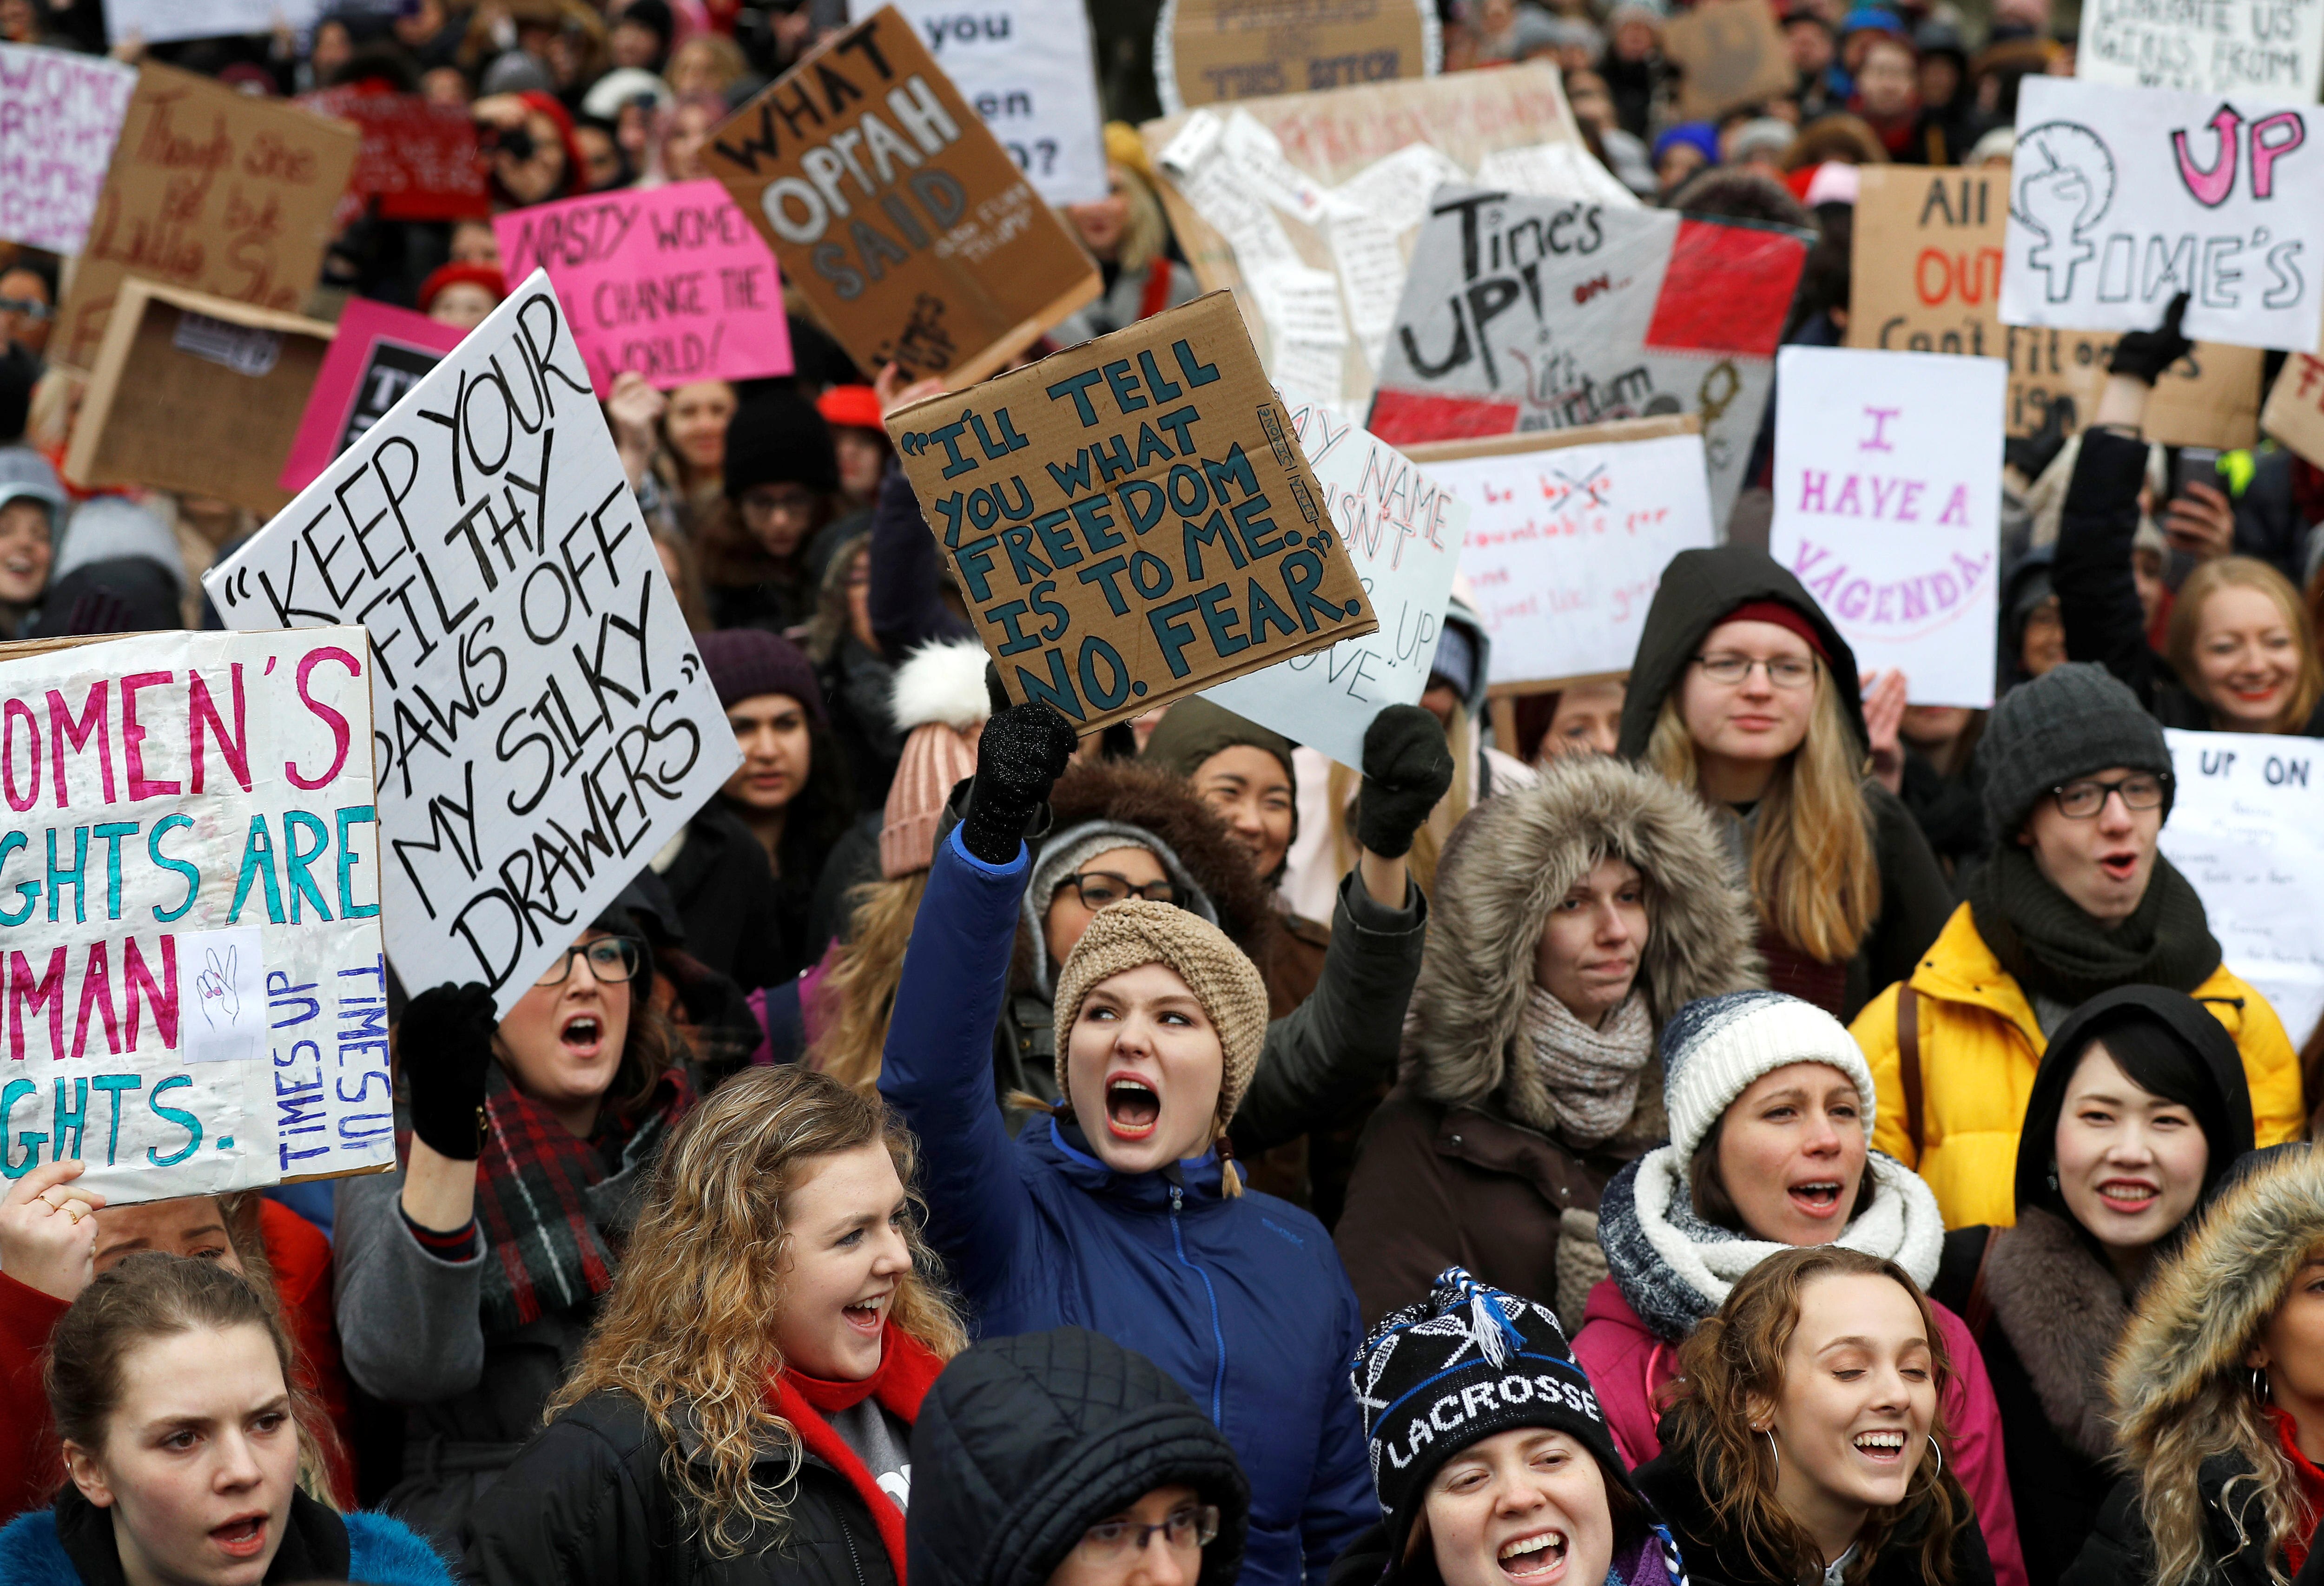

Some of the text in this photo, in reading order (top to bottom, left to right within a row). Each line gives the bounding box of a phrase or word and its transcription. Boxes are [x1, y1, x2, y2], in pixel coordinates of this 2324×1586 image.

[924, 14, 1010, 51] you
[714, 21, 894, 174] WHAT
[975, 88, 1031, 120] en
[1920, 177, 1987, 226] All
[2171, 103, 2304, 208] UP
[509, 201, 639, 280] NASTY
[813, 169, 967, 301] SAID
[594, 271, 706, 329] CHANGE
[719, 265, 767, 311] THE
[1399, 263, 1550, 388] UP!
[597, 319, 725, 379] WORLD!
[1046, 339, 1221, 427] TELL
[417, 293, 592, 506] YOUR
[1859, 405, 1901, 453] I
[935, 405, 1201, 549] YOU WHAT
[952, 441, 1260, 604] FREEDOM
[1291, 477, 1318, 520] NINA
[1357, 441, 1454, 553] NAME
[1483, 481, 1514, 505] be
[1627, 507, 1669, 534] for
[1798, 467, 1970, 525] HAVE A
[520, 481, 633, 645] OFF
[1326, 482, 1417, 572] ISN'T
[985, 580, 1070, 657] IS
[1076, 549, 1174, 617] TO
[1792, 538, 1991, 624] VAGENDA.
[1017, 548, 1361, 721] NO. FEAR.
[0, 645, 363, 812] OMEN'S
[392, 570, 653, 919] MY SILKY
[2200, 748, 2311, 789] UP ON
[0, 805, 380, 928] GHTS ARE
[0, 933, 180, 1062] MAN
[266, 969, 321, 1030] UP
[1, 1073, 235, 1179] GHTS.
[1388, 1374, 1600, 1469] LACROSSE
